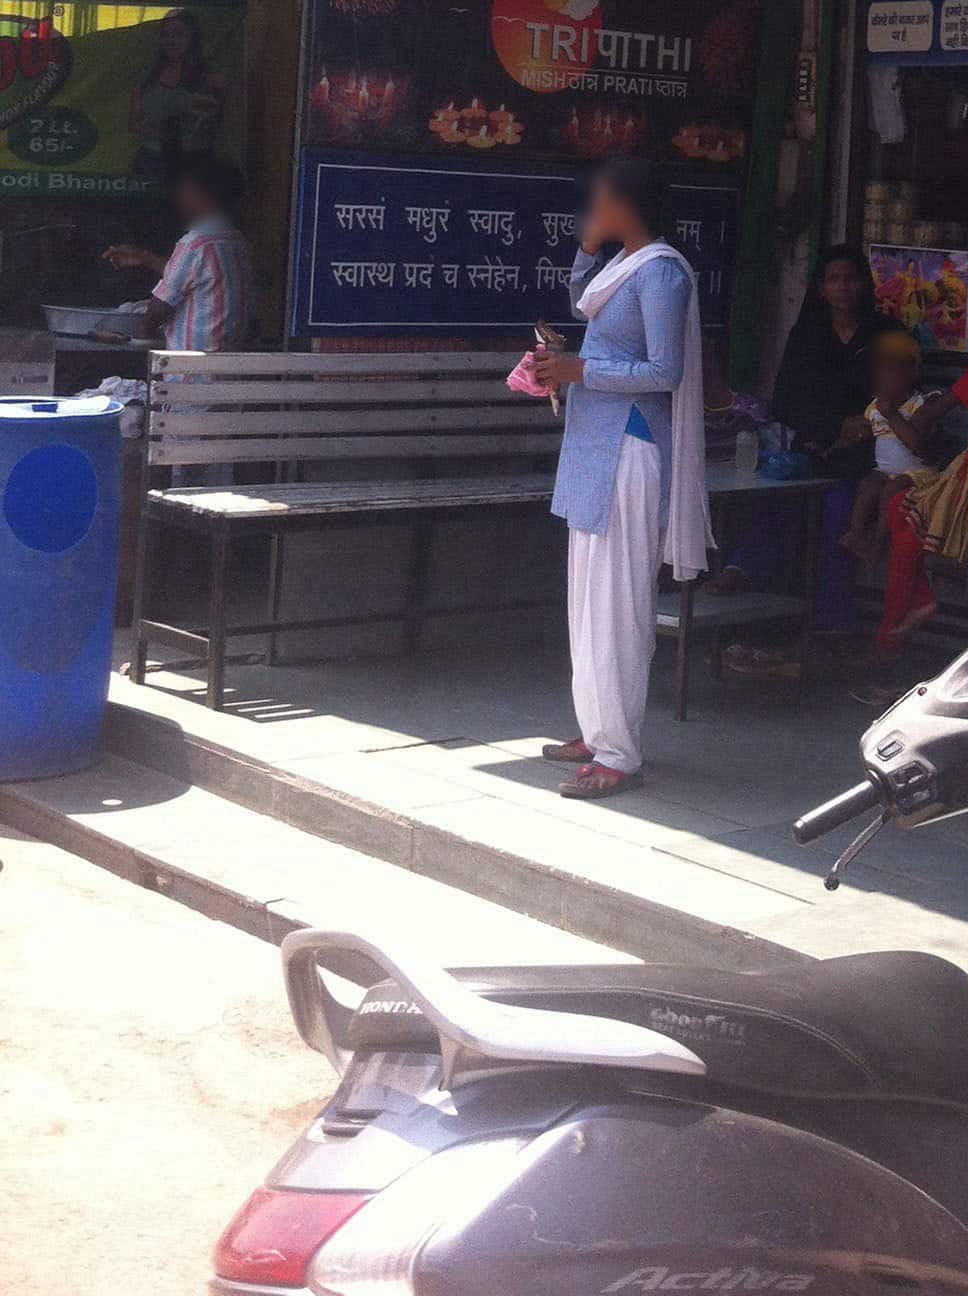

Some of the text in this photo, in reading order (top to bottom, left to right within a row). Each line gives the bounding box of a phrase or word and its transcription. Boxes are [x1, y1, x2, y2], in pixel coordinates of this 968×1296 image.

[526, 22, 692, 72] TRIपाTHI
[47, 173, 151, 192] Bhandar
[334, 197, 386, 231] सरसं
[441, 263, 459, 289] च
[359, 1001, 423, 1015] HONDA
[600, 1266, 815, 1293] Activa
